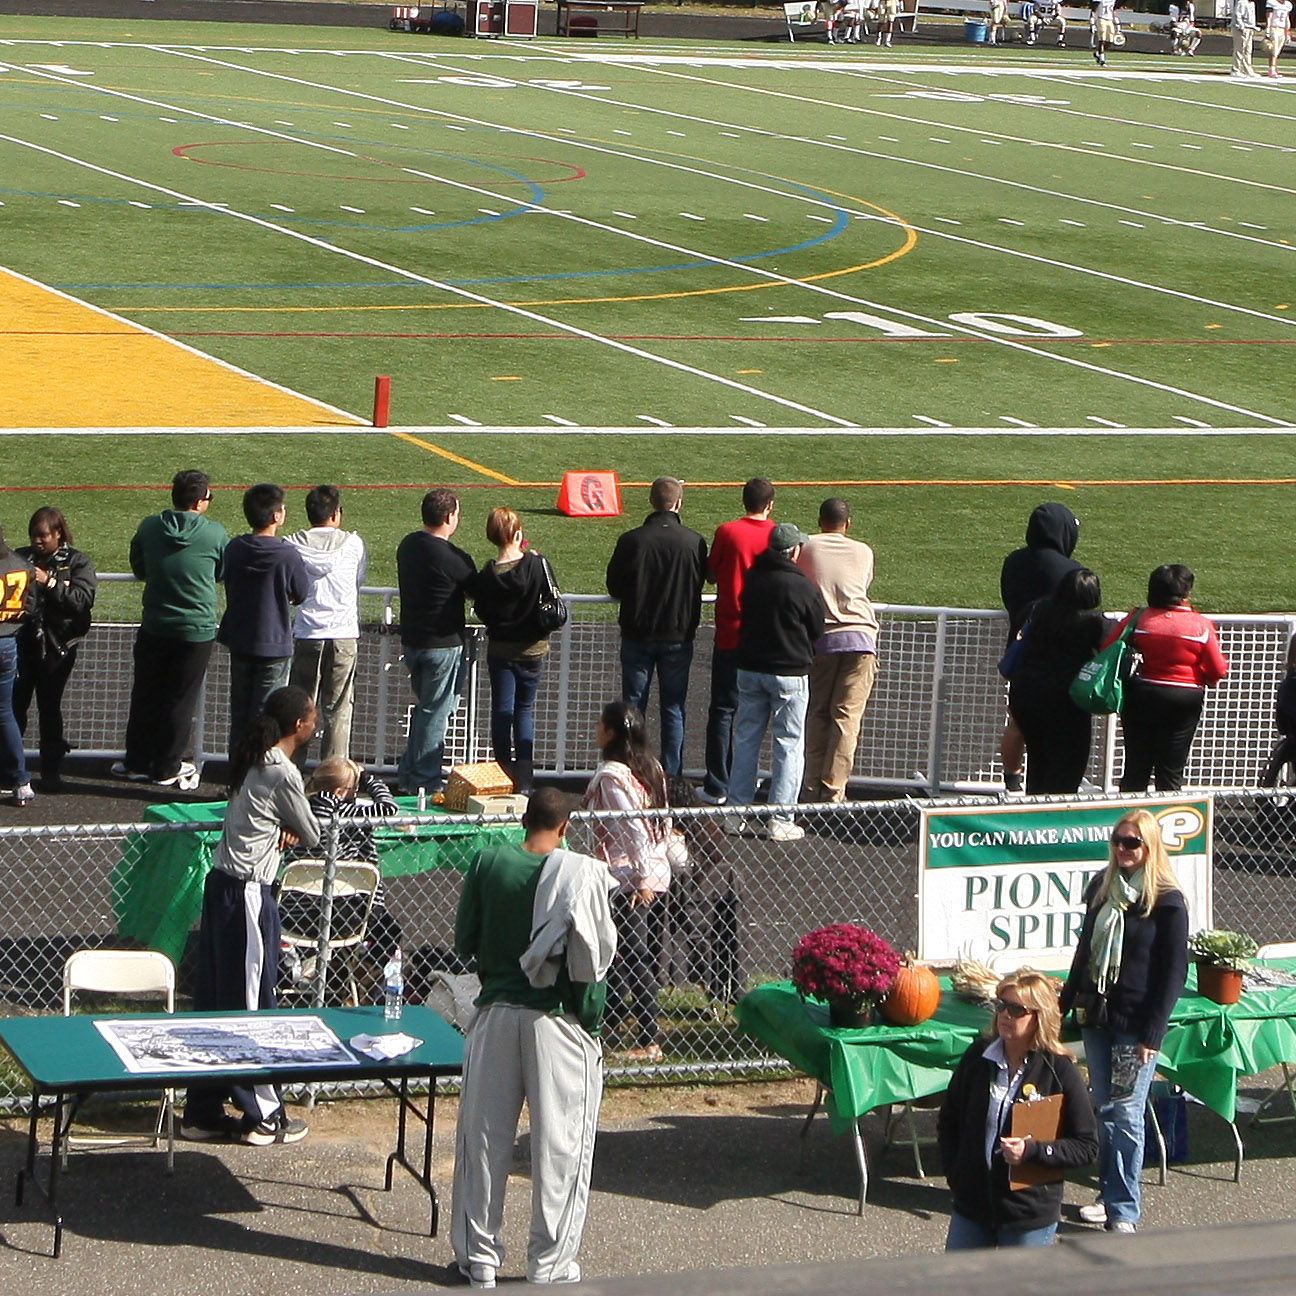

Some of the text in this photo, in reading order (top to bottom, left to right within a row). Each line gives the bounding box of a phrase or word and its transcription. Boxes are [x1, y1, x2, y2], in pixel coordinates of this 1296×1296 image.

[581, 476, 604, 511] G
[929, 832, 965, 849] YOU
[968, 831, 1005, 847] CAN
[1008, 829, 1058, 846] MAKE
[1061, 827, 1085, 843] AN
